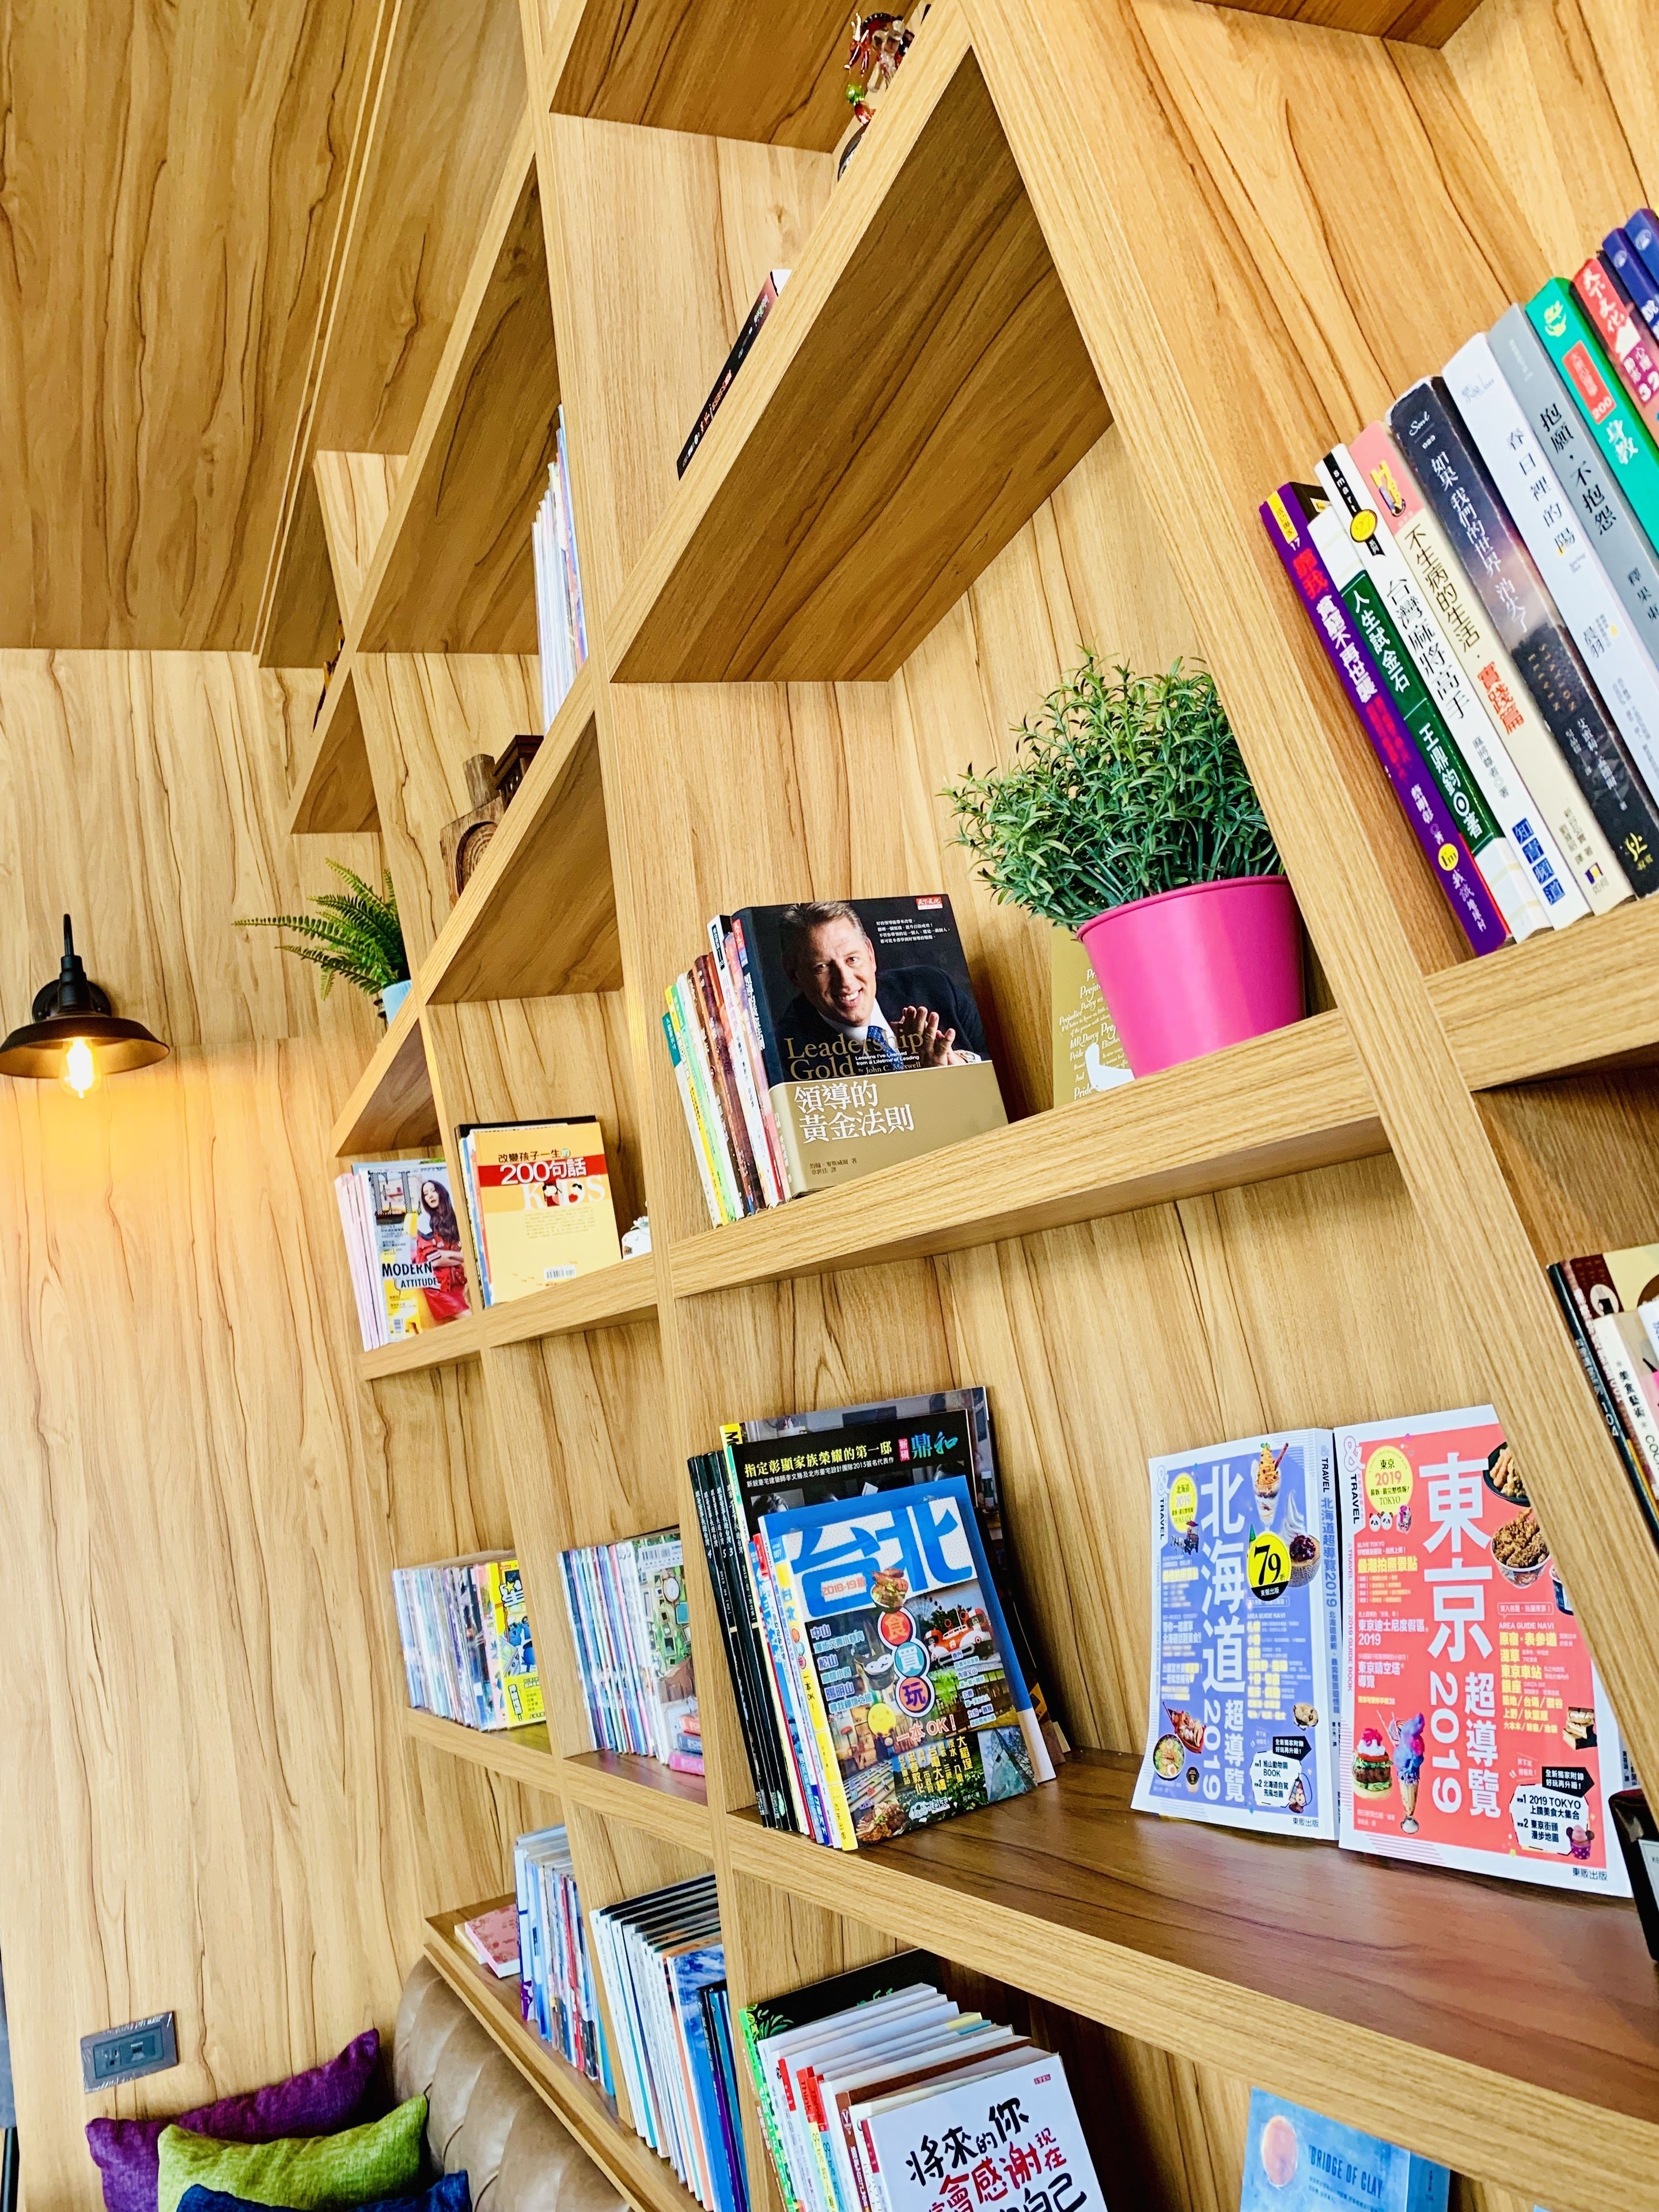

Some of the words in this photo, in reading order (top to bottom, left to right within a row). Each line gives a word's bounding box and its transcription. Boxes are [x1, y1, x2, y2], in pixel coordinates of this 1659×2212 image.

[1591, 395, 1613, 421] 200
[1290, 537, 1300, 551] 17
[1431, 450, 1459, 491] 如果
[1450, 486, 1502, 577] 我們的世界
[1496, 577, 1528, 633] 消失了
[1354, 590, 1411, 693] 人生試金石
[1387, 579, 1470, 720] 台灣麻將高手
[1478, 660, 1524, 735] 實踐篇
[1512, 818, 1566, 906] 知青頻道
[784, 1028, 924, 1059] Leadership
[900, 1055, 920, 1063] Leading
[1070, 1051, 1085, 1061] Pride
[790, 1055, 857, 1081] Gold
[865, 1065, 882, 1075] John
[892, 1062, 922, 1071] Maxwell
[794, 1080, 879, 1114] 領導的
[1074, 1082, 1093, 1100] Pride
[799, 1104, 915, 1144] 黃金法則
[499, 1157, 587, 1185] 200句話
[382, 1262, 433, 1277] MODERN
[400, 1277, 438, 1289] ATTITUDE
[744, 1441, 892, 1478] 指定彰顯家族榮耀的第一邸
[1380, 1458, 1395, 1470] 東京
[1321, 1457, 1330, 1493] TRAVEL
[1374, 1470, 1403, 1486] 2019
[1176, 1484, 1190, 1494] 北海道
[1175, 1495, 1192, 1508] 2019
[1350, 1474, 1361, 1525] TRAVEL
[1379, 1495, 1401, 1506] TOKYO
[707, 1548, 713, 1559] 4
[722, 1548, 727, 1558] 5
[729, 1547, 734, 1557] 3
[1321, 1497, 1338, 1608] 北海道超導覽2019
[1418, 1451, 1493, 1665] 東京
[790, 1508, 974, 1618] 台北
[1358, 1556, 1418, 1574] 最潮拍照景點
[1200, 1463, 1246, 1694] 北海道
[1260, 1588, 1281, 1598] 東販出版
[810, 1623, 831, 1641] 中山
[1358, 1633, 1381, 1646] 2019
[1499, 1631, 1558, 1647] 原宿・表參道
[817, 1653, 839, 1671] 松山
[1501, 1664, 1542, 1680] 東京車站
[824, 1682, 855, 1700] 陽明山
[896, 1724, 926, 1743] 一本
[926, 1714, 957, 1737] OK!
[1203, 1698, 1222, 1801] 2019
[1224, 1699, 1245, 1803] 超導覽
[1430, 1671, 1463, 1813] 2019
[1464, 1671, 1501, 1819] 超導覽
[1263, 1769, 1281, 1778] BOOK
[1546, 1769, 1584, 1781] 全新獨家附錄
[1263, 1781, 1289, 1791] 北海道自駕
[1546, 1778, 1582, 1790] 好玩再升級!
[1529, 1795, 1548, 1805] 2019
[1551, 1797, 1581, 1809] TOKYO
[1293, 1817, 1319, 1828] 東販出版
[1531, 1820, 1558, 1832] 東京街頭
[1532, 1830, 1559, 1843] 漫步地圖
[1572, 1868, 1608, 1881] 東販出版
[801, 2080, 812, 2113] Think
[1309, 2144, 1343, 2179] BRIDGE
[1345, 2162, 1358, 2187] OF
[1361, 2169, 1384, 2200] CLAY
